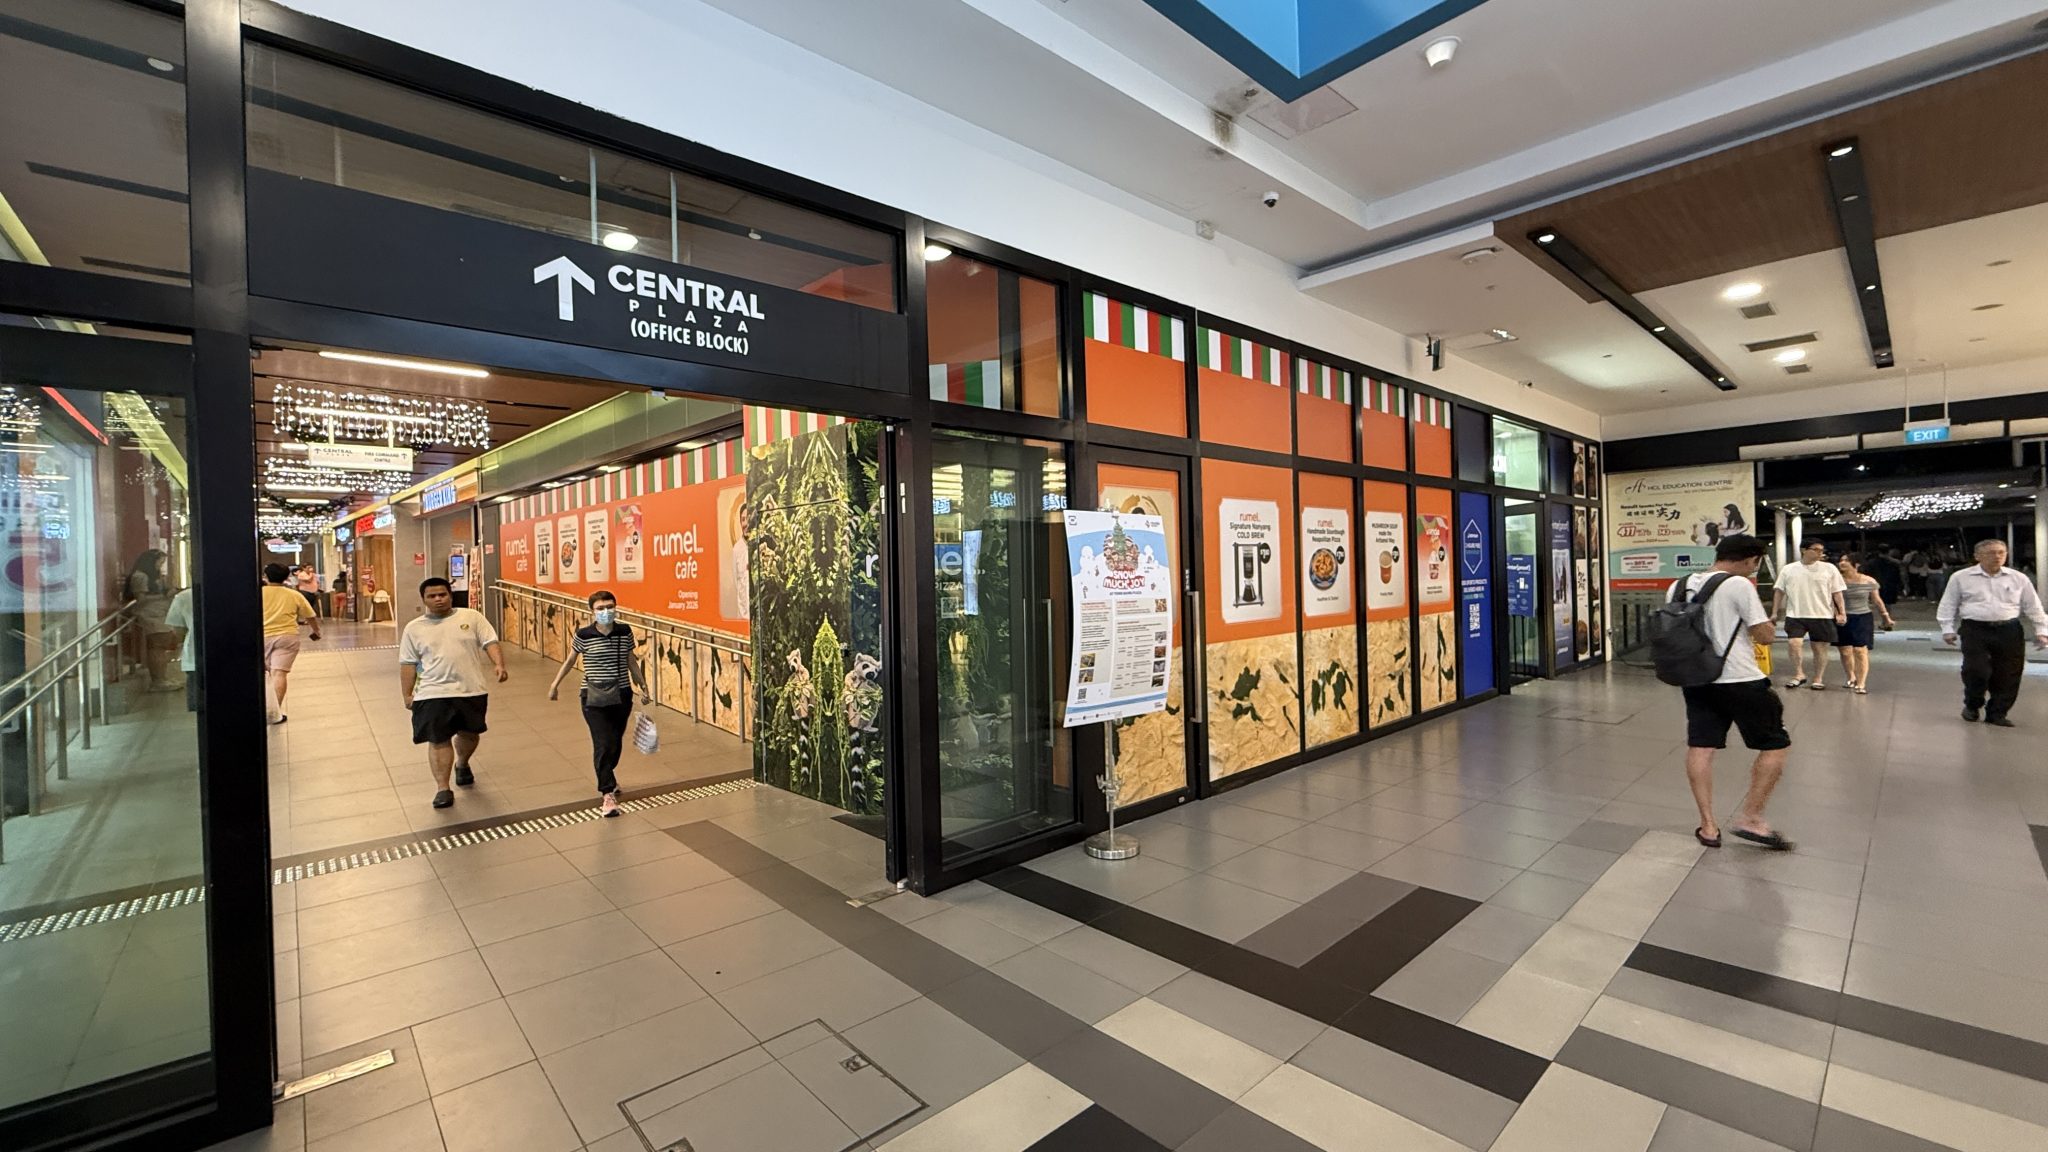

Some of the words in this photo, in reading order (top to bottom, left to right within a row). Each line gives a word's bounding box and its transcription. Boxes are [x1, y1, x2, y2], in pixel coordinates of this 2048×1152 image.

[608, 265, 765, 320] CENTRAL
[629, 299, 749, 333] PLAZA
[631, 318, 691, 345] (OFFICE
[696, 333, 749, 355] BLOCK)
[1913, 429, 1941, 441] EXIT
[1663, 482, 1702, 490] EDUCATION
[1704, 479, 1733, 487] CENTRE
[1230, 521, 1251, 530] Signature
[1237, 531, 1250, 539] COLD
[1251, 531, 1265, 539] BREW
[1113, 570, 1136, 579] SNOW
[1103, 577, 1128, 589] MUCH
[1128, 576, 1145, 589] JOY
[678, 589, 699, 600] Opening
[668, 600, 686, 610] January
